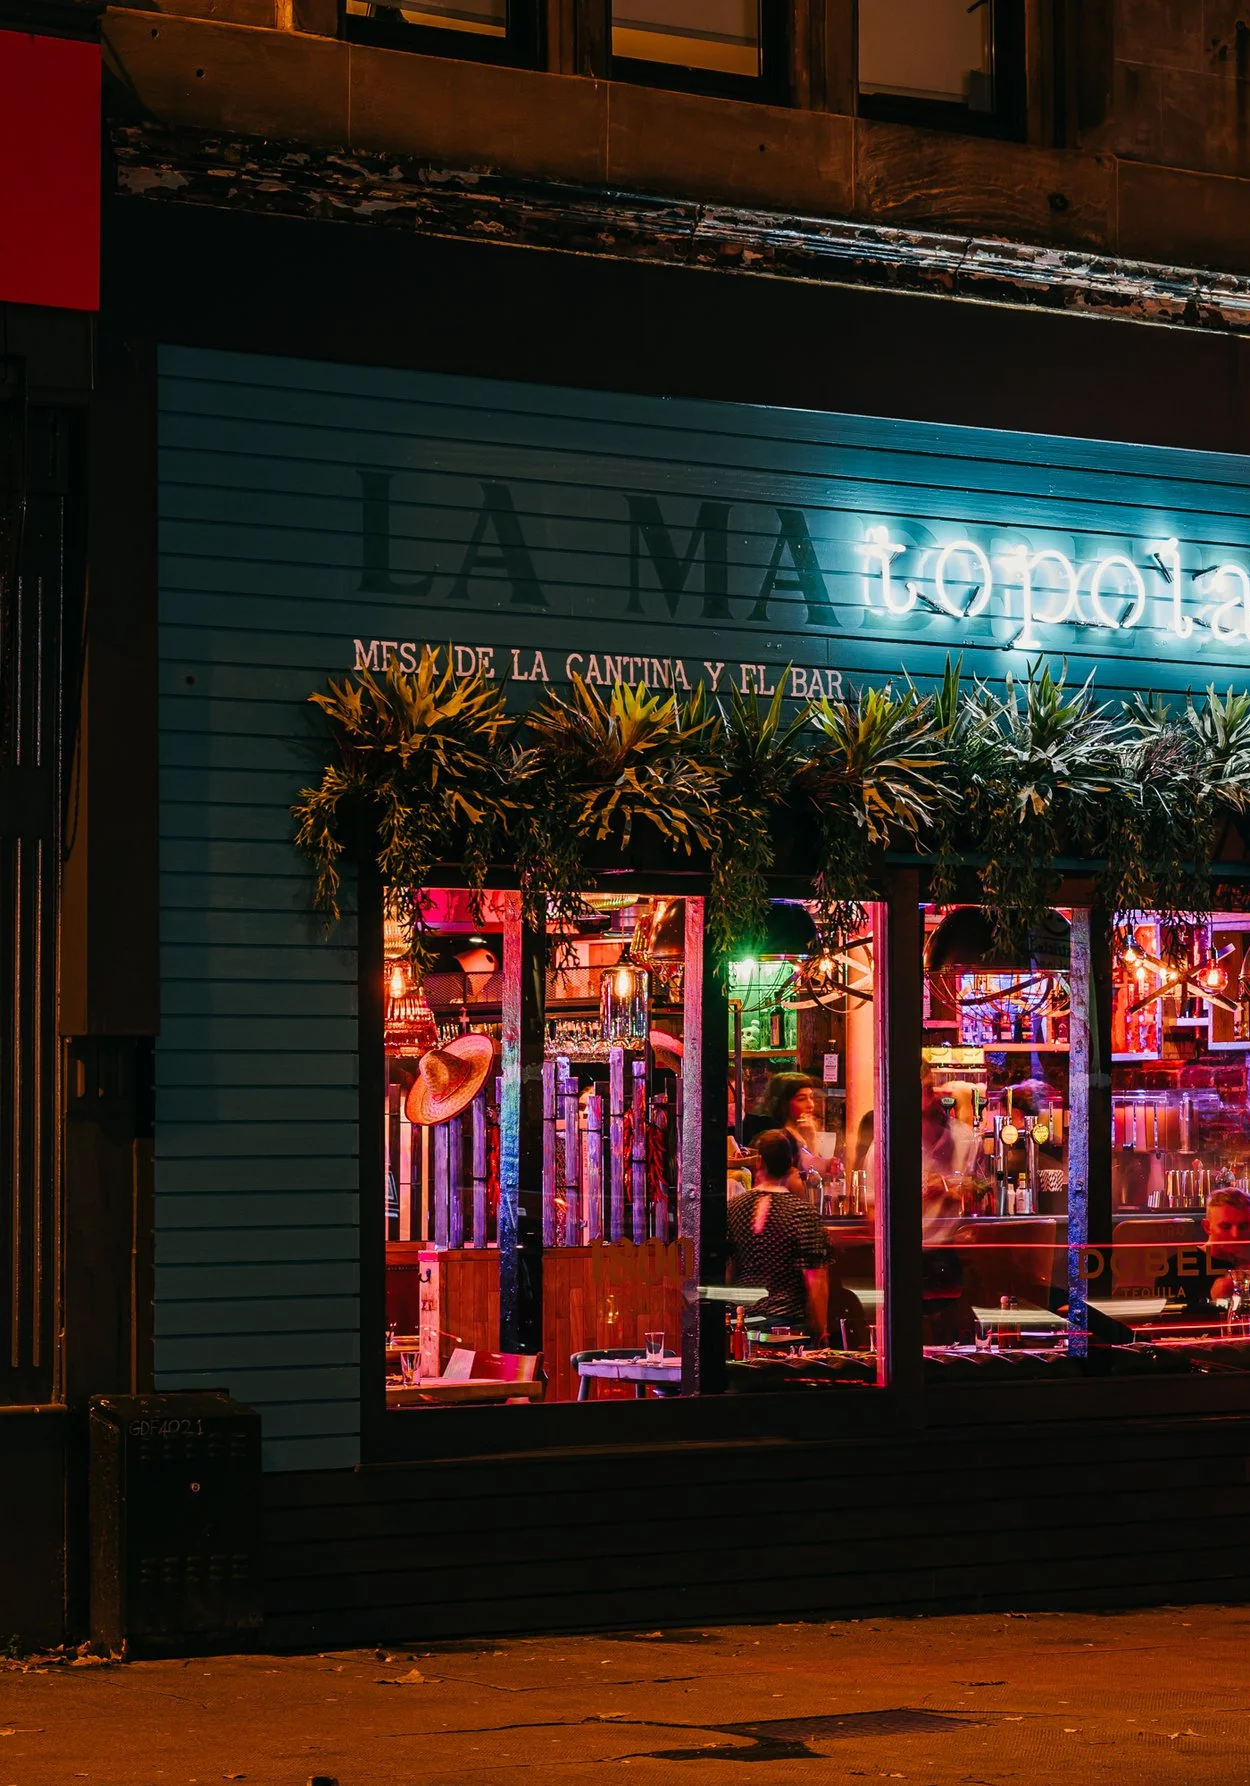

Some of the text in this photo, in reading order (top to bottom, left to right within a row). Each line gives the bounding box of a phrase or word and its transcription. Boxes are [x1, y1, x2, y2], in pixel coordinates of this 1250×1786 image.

[355, 469, 551, 609] LA
[454, 646, 495, 680] DE
[511, 648, 550, 683] LA
[565, 652, 692, 692] CANTINA
[703, 661, 726, 692] Y
[790, 666, 846, 701] BAR
[1120, 1285, 1188, 1301] TEQUILA
